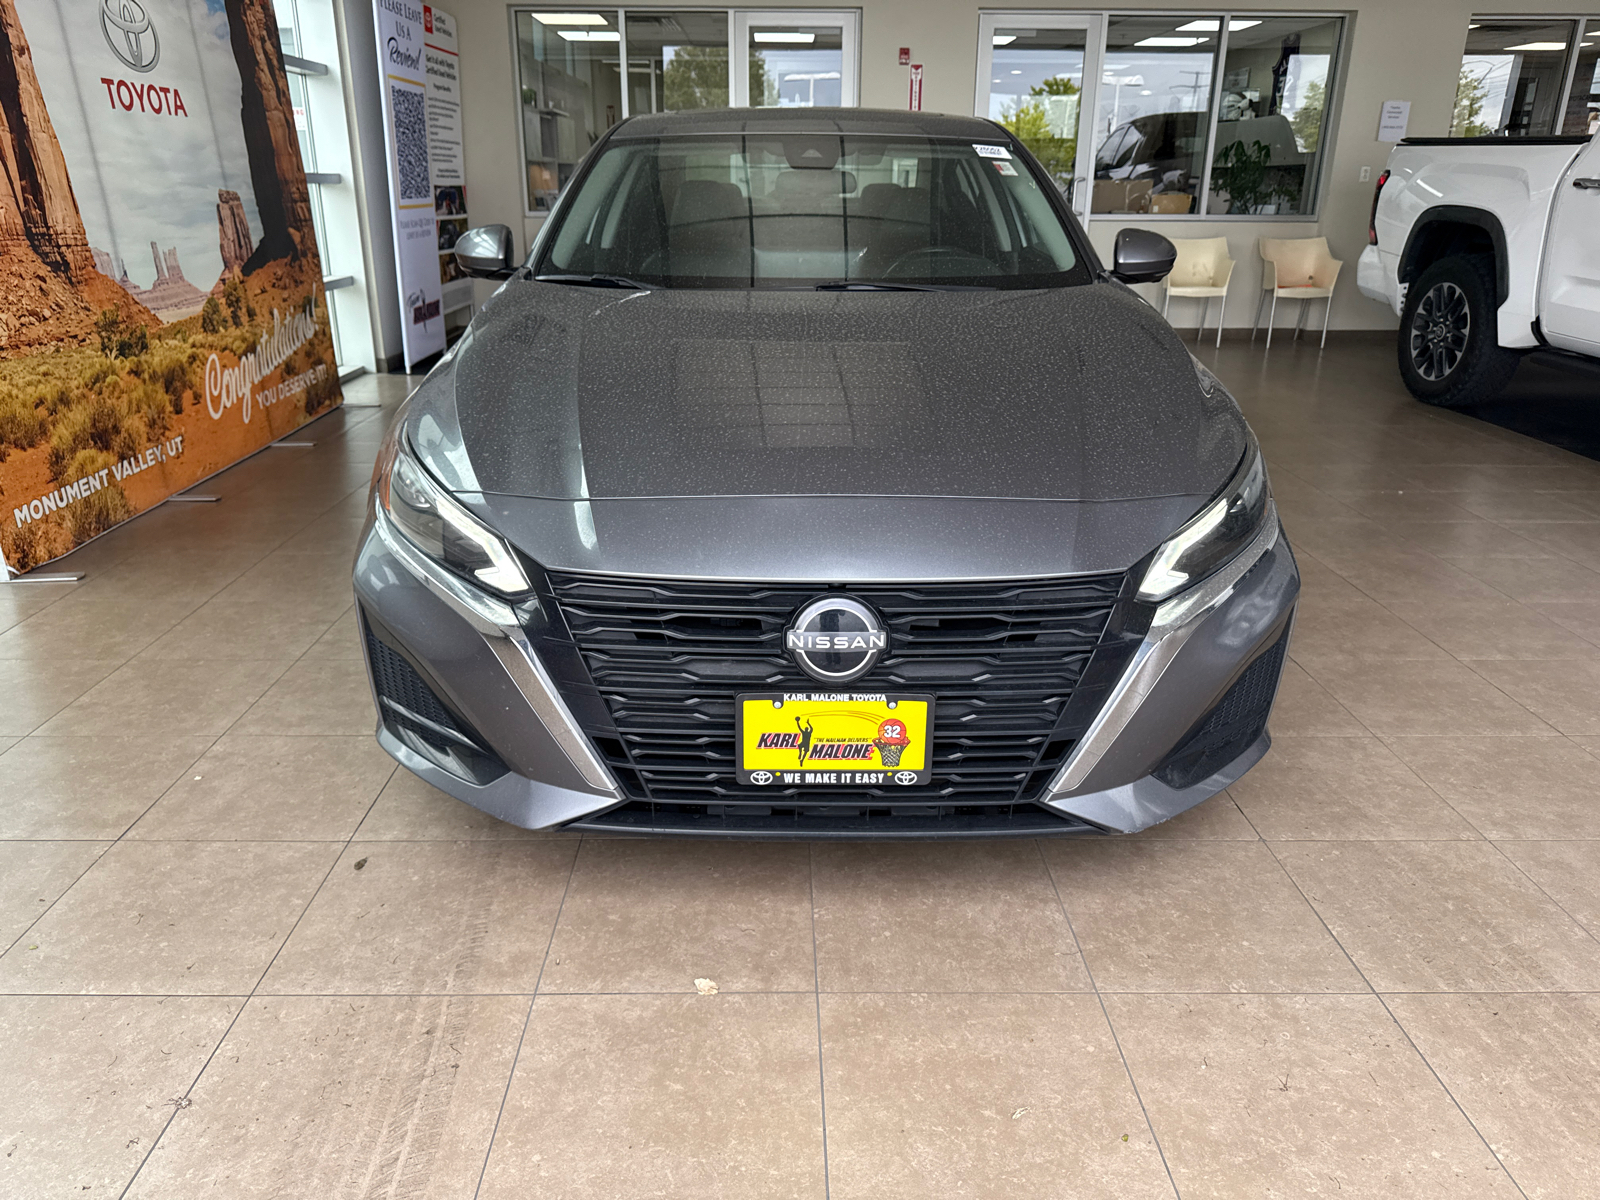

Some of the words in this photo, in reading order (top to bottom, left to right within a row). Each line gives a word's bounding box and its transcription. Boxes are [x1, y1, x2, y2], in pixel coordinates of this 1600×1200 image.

[404, 3, 422, 25] LEAVE
[100, 77, 188, 118] TOYOTA
[205, 281, 319, 424] Congratulations!
[256, 386, 277, 409] YOU
[280, 369, 317, 400] DESERVE
[13, 468, 109, 529] MONUMENT
[111, 444, 167, 482] VALLEY,
[166, 435, 183, 457] UT
[788, 635, 884, 649] NISSAN
[783, 693, 809, 702] KARL
[810, 693, 850, 702] MALONE
[851, 693, 887, 702] TOYOTA
[884, 725, 901, 738] 32
[756, 732, 801, 749] KARL
[808, 743, 875, 760] MALONE
[784, 773, 801, 784] WE
[805, 773, 837, 784] MAKE
[841, 773, 852, 784] IT
[855, 773, 884, 784] EASY
